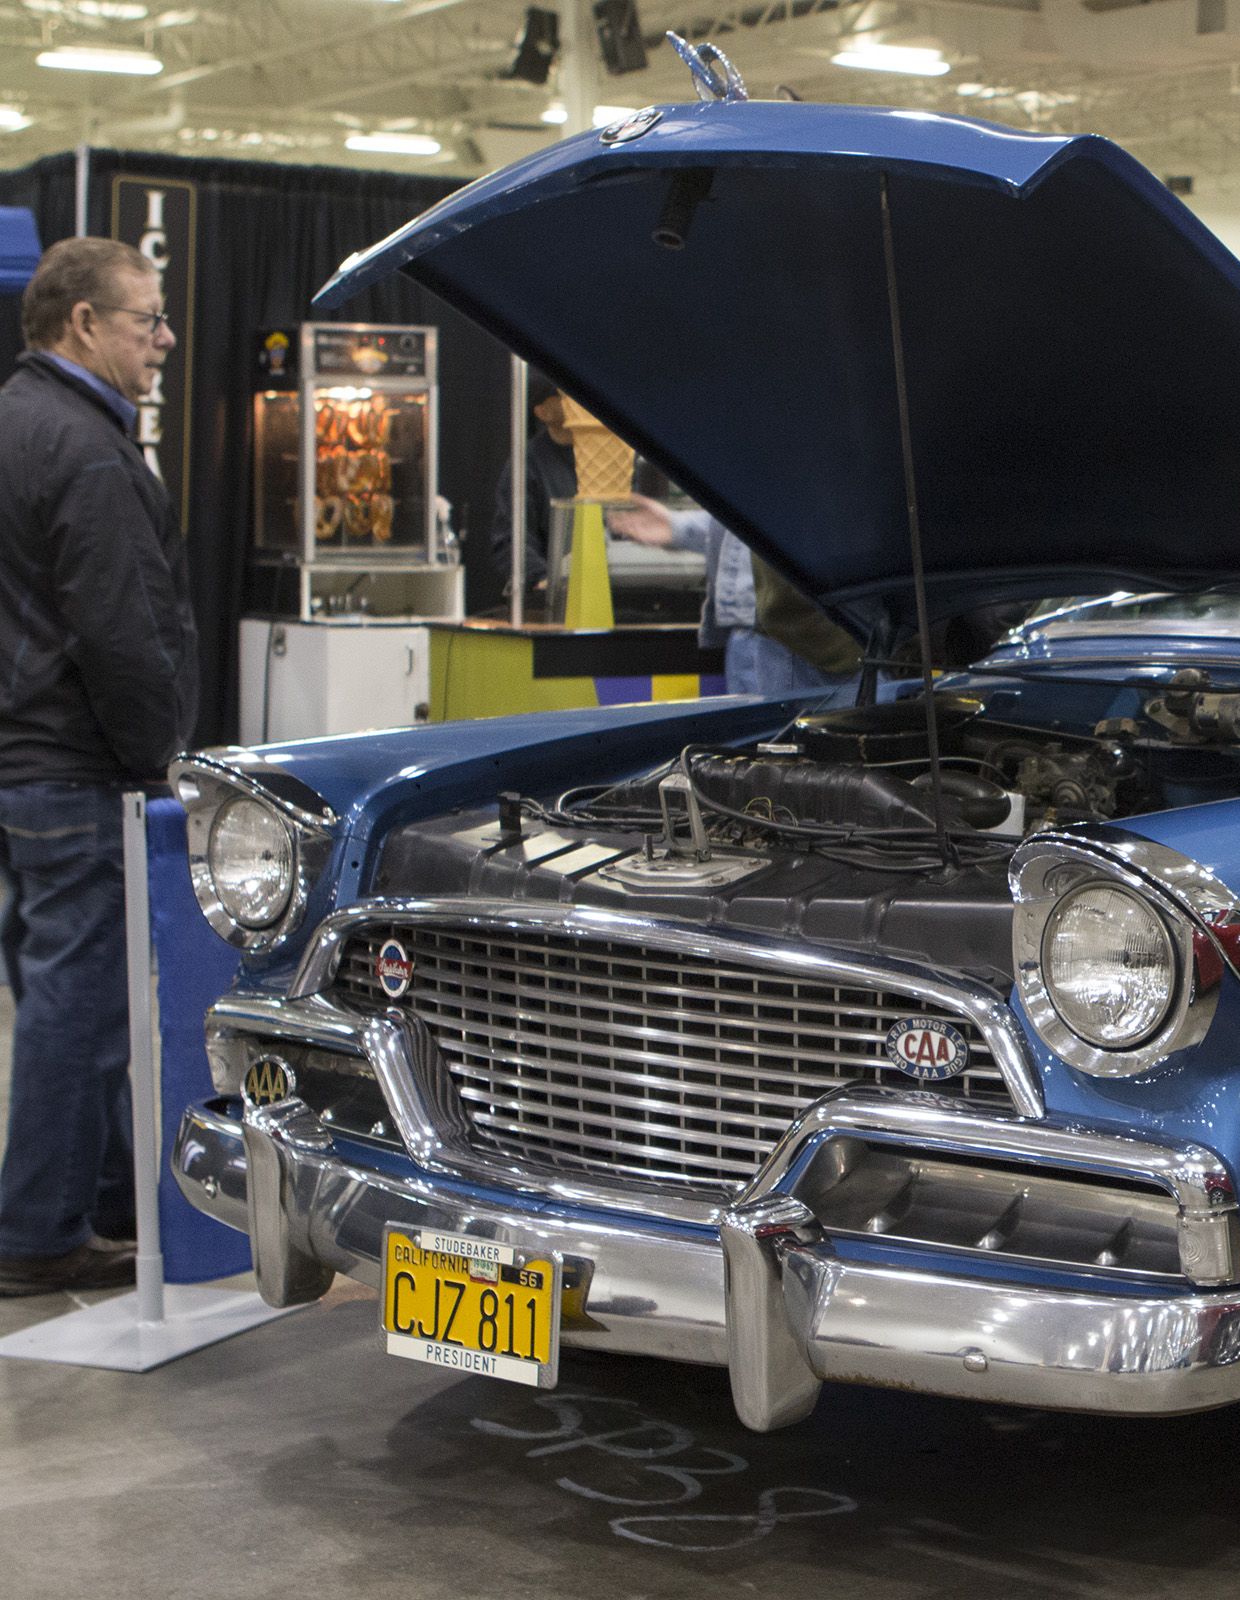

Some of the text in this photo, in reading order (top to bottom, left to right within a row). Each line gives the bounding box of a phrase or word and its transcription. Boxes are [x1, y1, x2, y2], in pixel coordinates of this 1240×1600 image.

[904, 1031, 950, 1068] CAA
[912, 1019, 947, 1034] MOTOR
[944, 1031, 965, 1076] LEAGUE
[246, 1062, 286, 1106] AAA
[912, 1068, 940, 1079] AAA
[395, 1245, 469, 1275] CALIFORNIA
[434, 1236, 500, 1261] STUDEBAKER
[519, 1271, 538, 1288] 56
[393, 1271, 541, 1364] CJZ 811
[426, 1344, 498, 1374] PRESIDENT
